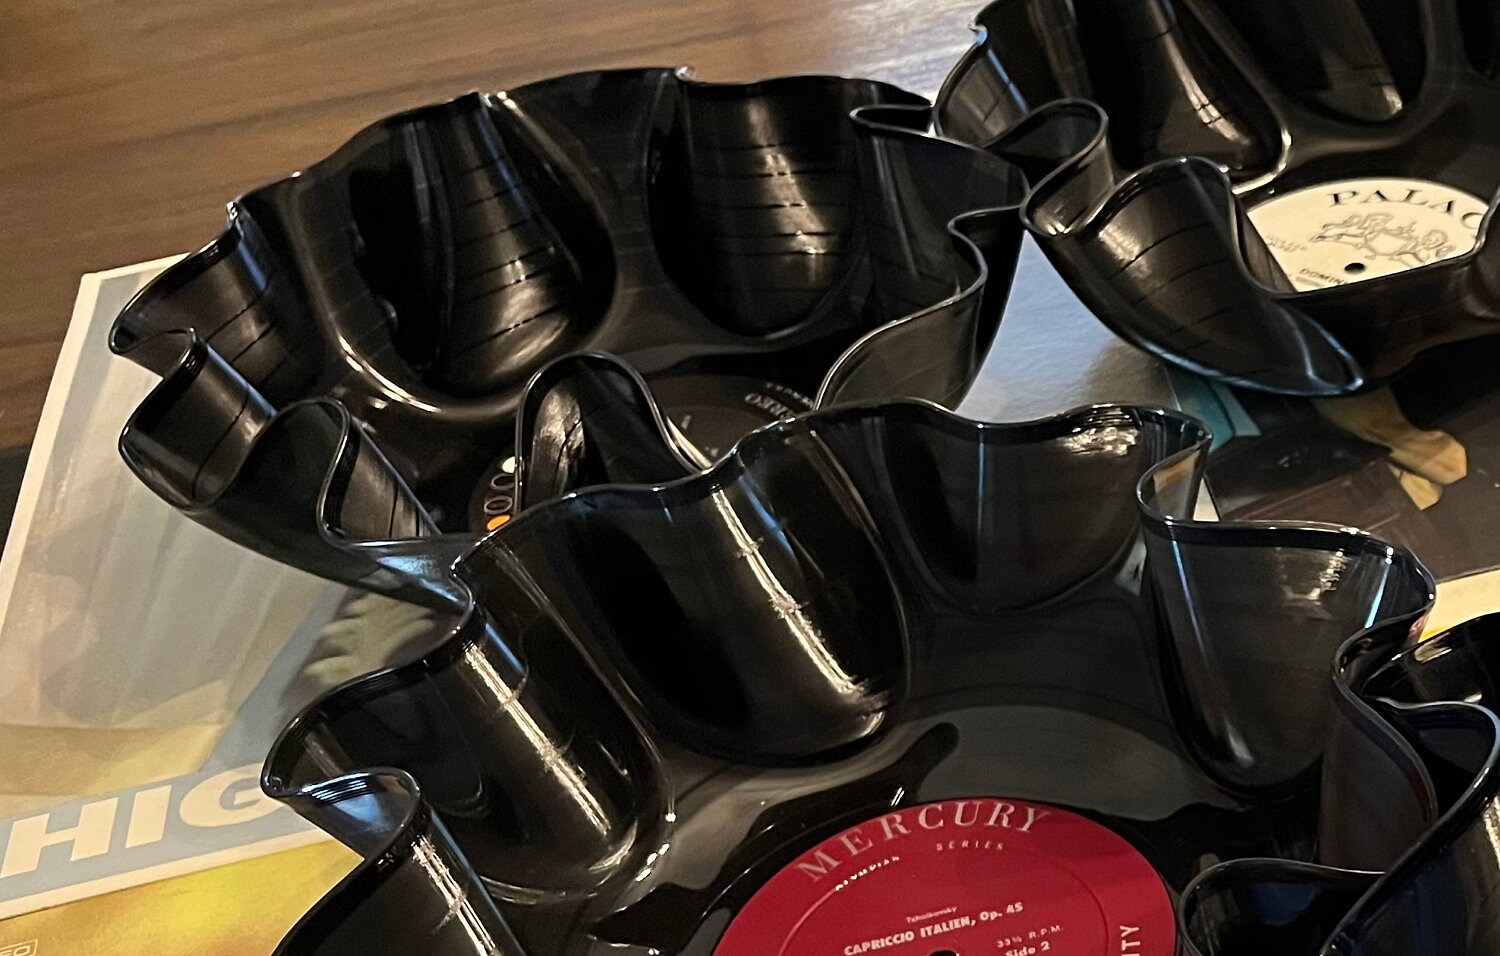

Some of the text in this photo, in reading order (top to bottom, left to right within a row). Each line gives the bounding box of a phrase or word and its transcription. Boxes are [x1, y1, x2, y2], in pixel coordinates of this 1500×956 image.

[1328, 188, 1487, 230] PALAC
[794, 800, 1055, 882] MERCURY
[936, 839, 1005, 852] SERIES
[905, 905, 958, 924] Tchaikovsky
[843, 901, 1024, 956] CAPRICCIO ITALIEN, Op. 45
[1028, 924, 1064, 940] R.P.M.
[1040, 940, 1051, 954] 2
